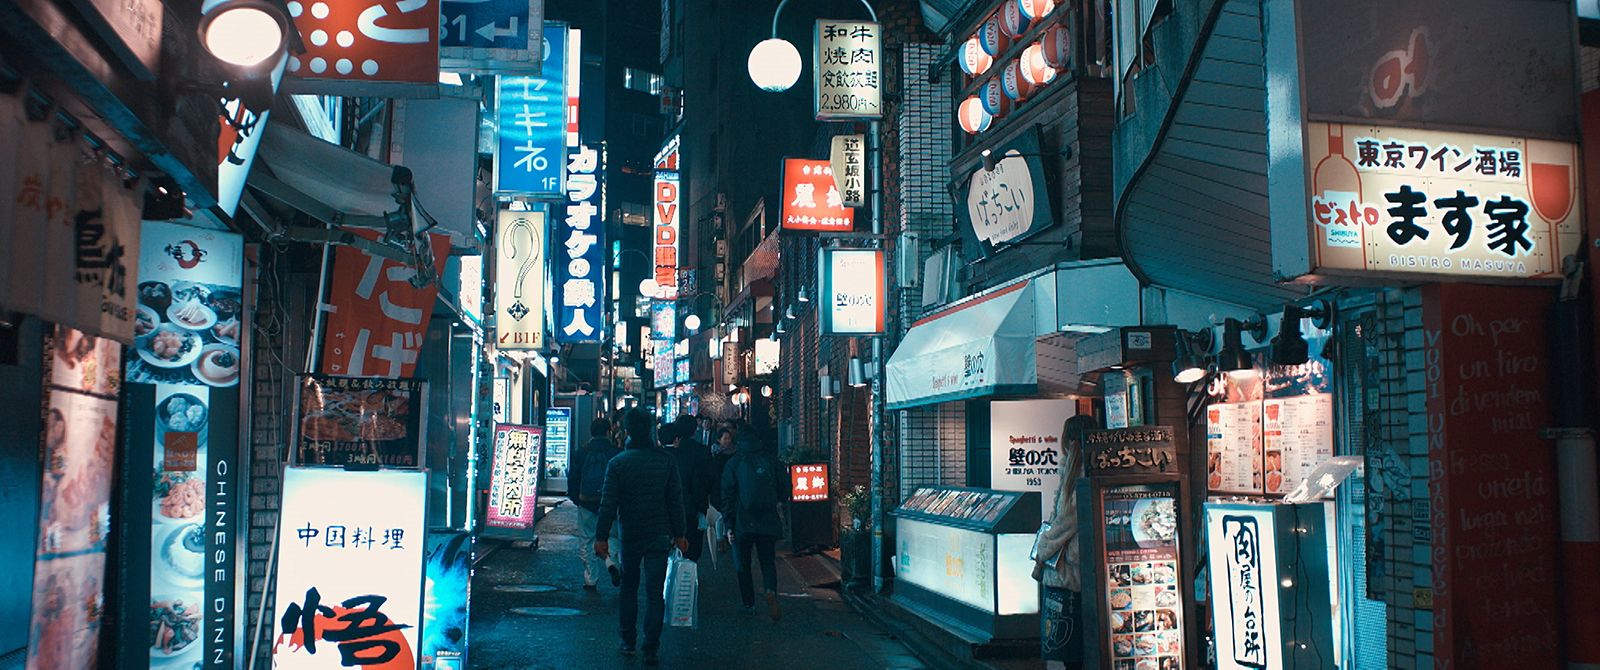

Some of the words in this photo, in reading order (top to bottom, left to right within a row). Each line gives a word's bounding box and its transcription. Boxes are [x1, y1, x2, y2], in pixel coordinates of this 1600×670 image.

[823, 25, 873, 42] 和牛
[823, 47, 874, 65] 焼肉
[844, 138, 861, 203] 道玄坂小路
[1356, 139, 1521, 178] 東京ワイン酒場
[541, 177, 557, 190] 1F
[975, 183, 1025, 227] ばっちこい
[1313, 199, 1379, 227] ビストロ
[1330, 229, 1359, 238] SHIBUYA
[1384, 184, 1533, 256] ます家
[563, 144, 599, 337] カラオケの鉄人
[1390, 256, 1452, 269] BISTRO
[1462, 259, 1526, 272] MASUYA
[513, 331, 541, 344] B1F
[1008, 447, 1058, 467] 壁の穴
[1091, 446, 1172, 470] ばっちこい
[1026, 478, 1042, 486] 1953
[214, 459, 228, 583] CHINESE
[296, 522, 405, 551] 中国料理
[212, 597, 227, 666] DINN
[281, 586, 415, 668] 悟
